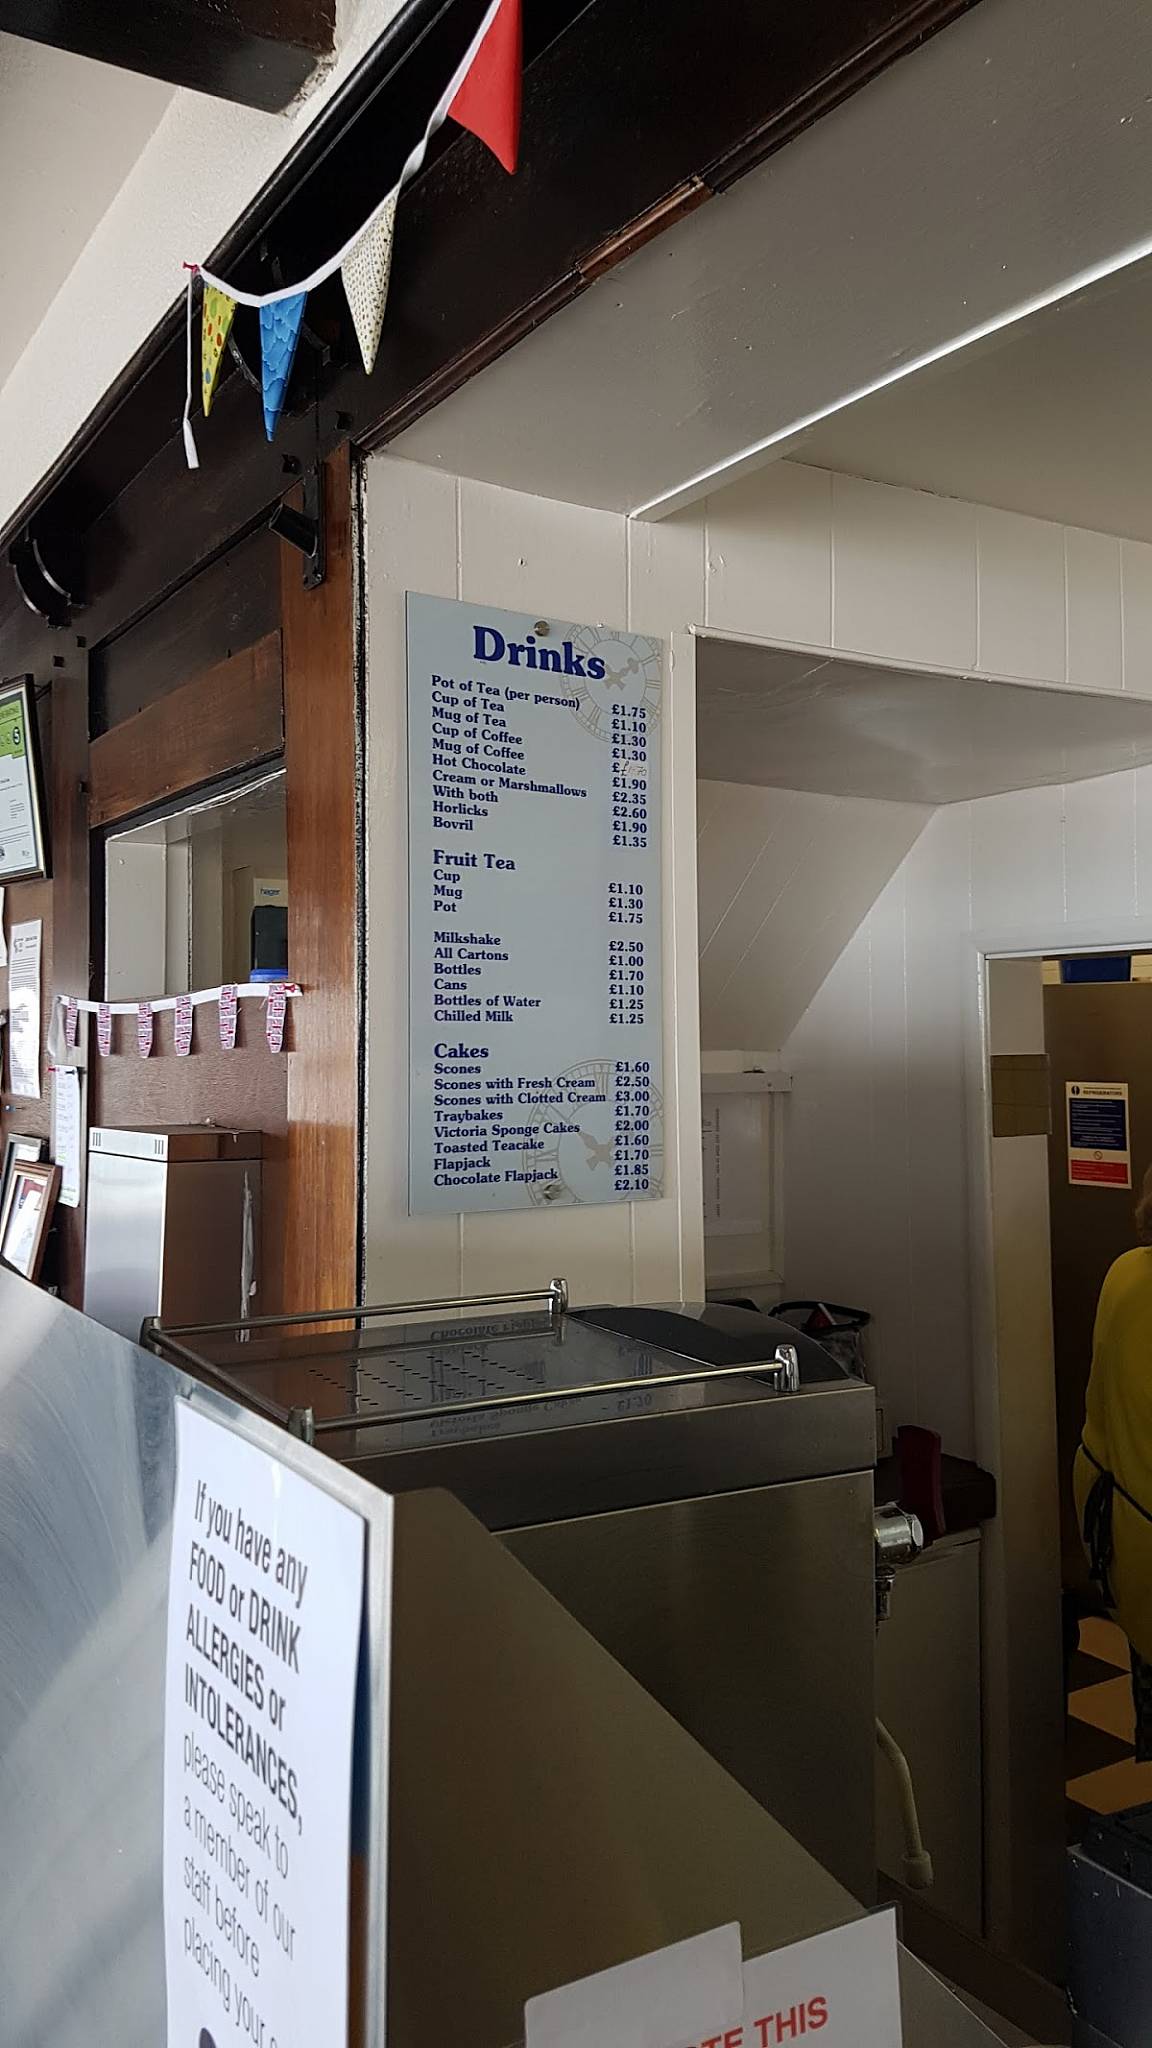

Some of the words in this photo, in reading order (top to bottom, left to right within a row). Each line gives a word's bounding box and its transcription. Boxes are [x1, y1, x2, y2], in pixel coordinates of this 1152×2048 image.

[473, 625, 606, 680] Drinks
[431, 674, 455, 689] Pot
[459, 680, 473, 692] of
[476, 682, 500, 696] Tea
[504, 686, 530, 701] (per
[534, 694, 580, 711] person)
[432, 691, 459, 707] Cup
[463, 696, 477, 708] of
[480, 698, 504, 712] Tea
[432, 706, 461, 723] Mug
[465, 712, 480, 723] of
[482, 713, 506, 727] Tea
[611, 704, 646, 719] £1.75
[611, 718, 646, 733] £1.10
[432, 722, 459, 738] Cup
[464, 727, 478, 739] of
[481, 729, 522, 745] Coffee
[611, 733, 646, 747] £1.30
[432, 737, 462, 755] Mug
[466, 743, 480, 754] of
[483, 744, 524, 760] Coffee
[612, 748, 647, 762] £1.30
[432, 753, 457, 767] Hot
[461, 757, 526, 775] Chocolate
[432, 769, 476, 785] Cream
[480, 778, 495, 787] or
[499, 777, 587, 797] Marshmallows
[612, 777, 647, 790] £1.90
[433, 784, 464, 799] With
[468, 788, 498, 803] both
[612, 791, 646, 805] £2.35
[432, 800, 488, 816] Horlicks
[612, 806, 647, 819] £2.60
[433, 816, 473, 831] Bovril
[612, 820, 647, 834] £1.90
[612, 834, 647, 848] £1.35
[433, 849, 478, 867] Fruit
[483, 853, 516, 870] Tea
[433, 869, 460, 884] Cup
[433, 884, 463, 900] Mug
[608, 882, 643, 895] £1.10
[434, 900, 457, 912] Pot
[608, 897, 643, 909] £1.30
[608, 911, 643, 924] £1.75
[434, 931, 501, 945] Milkshake
[434, 947, 453, 959] All
[457, 948, 509, 961] Cartons
[609, 941, 644, 953] £2.50
[608, 955, 644, 967] £1.00
[434, 963, 481, 975] Bottles
[609, 969, 644, 981] £1.70
[434, 978, 467, 990] Cans
[609, 984, 644, 995] £1.10
[434, 994, 482, 1006] Bottles
[486, 995, 500, 1006] of
[503, 995, 541, 1007] Water
[609, 998, 644, 1010] £1.25
[434, 1009, 481, 1022] Chilled
[485, 1010, 513, 1022] Milk
[609, 1013, 644, 1024] £1.25
[434, 1043, 489, 1059] Cakes
[434, 1062, 481, 1074] Scones
[615, 1061, 650, 1073] £1.60
[434, 1078, 481, 1090] Scones
[485, 1077, 514, 1089] with
[517, 1077, 552, 1088] Fresh
[556, 1077, 595, 1088] Cream
[615, 1075, 650, 1087] £2.50
[434, 1094, 482, 1106] Scones
[485, 1093, 514, 1105] with
[517, 1091, 564, 1104] Clotted
[567, 1092, 606, 1103] Cream
[615, 1090, 650, 1102] £3.00
[434, 1109, 503, 1124] Traybakes
[615, 1105, 650, 1116] £1.70
[434, 1125, 487, 1138] Victoria
[491, 1124, 539, 1138] Sponge
[543, 1122, 580, 1134] Cakes
[615, 1120, 649, 1131] £2.00
[433, 1140, 488, 1154] Toasted
[492, 1138, 544, 1151] Teacake
[614, 1134, 649, 1146] £1.60
[614, 1149, 649, 1161] £1.70
[434, 1156, 491, 1172] Flapjack
[614, 1164, 649, 1176] £1.85
[433, 1172, 501, 1186] Chocolate
[504, 1168, 559, 1184] Flapjack
[614, 1178, 649, 1191] £2.10
[194, 1479, 207, 1523] If
[206, 1497, 232, 1544] you
[235, 1507, 271, 1574] have
[276, 1547, 308, 1609] any
[189, 1540, 225, 1605] FOOD
[230, 1583, 245, 1623] or
[249, 1588, 301, 1674] DRINK
[186, 1603, 264, 1710] ALLERGIES
[269, 1688, 286, 1732] or
[185, 1662, 302, 1836] INTOLERANCES,
[184, 1731, 225, 1803] please
[229, 1782, 271, 1860] speak
[275, 1825, 289, 1879] to
[184, 1795, 192, 1831] a
[195, 1808, 250, 1898] member
[256, 1879, 269, 1924] of
[274, 1904, 296, 1960] our
[184, 1856, 211, 1915] staff
[215, 1883, 260, 1977] before
[184, 1917, 231, 2013] placing
[235, 1983, 265, 2048] your
[754, 1996, 828, 2048] THIS
